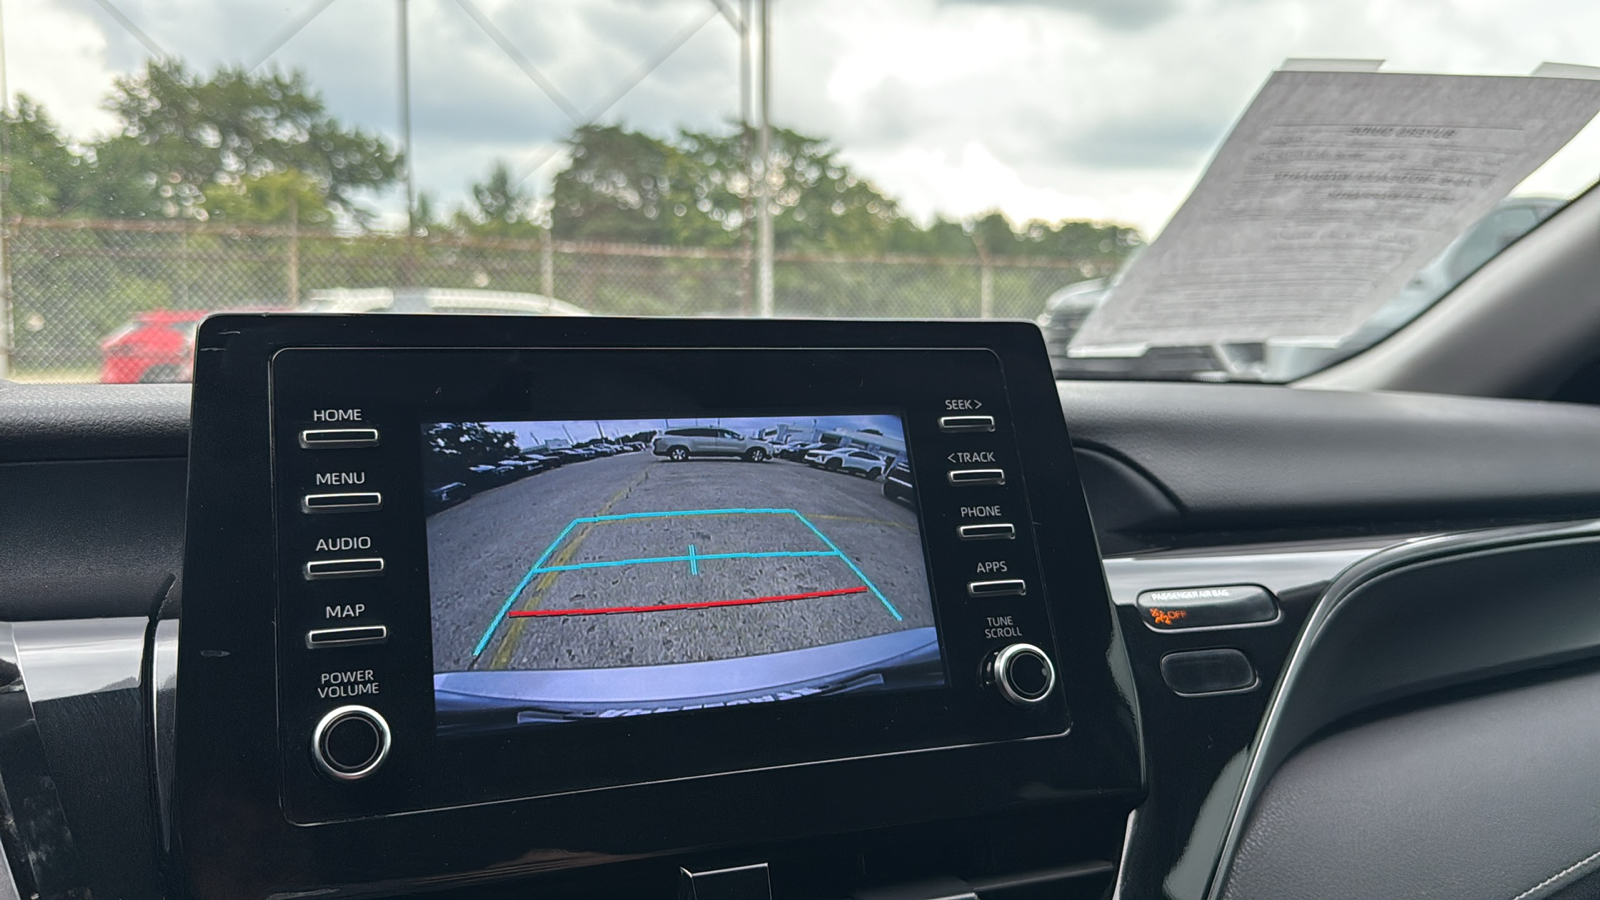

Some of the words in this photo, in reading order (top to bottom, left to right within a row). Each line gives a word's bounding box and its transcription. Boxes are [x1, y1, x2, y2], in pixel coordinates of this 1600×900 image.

[313, 408, 363, 422] HOME
[315, 471, 366, 486] MENU
[960, 505, 1002, 518] PHONE
[315, 536, 372, 551] AUDIO
[976, 560, 1008, 573] APPS
[1150, 591, 1199, 602] PASSENGER
[1213, 588, 1230, 598] BAG
[325, 603, 366, 619] MAP
[1167, 610, 1188, 620] OFF
[986, 615, 1014, 627] TUNE
[984, 626, 1023, 639] SCROLL
[320, 669, 375, 685] POWER
[317, 682, 380, 699] VOLUME
